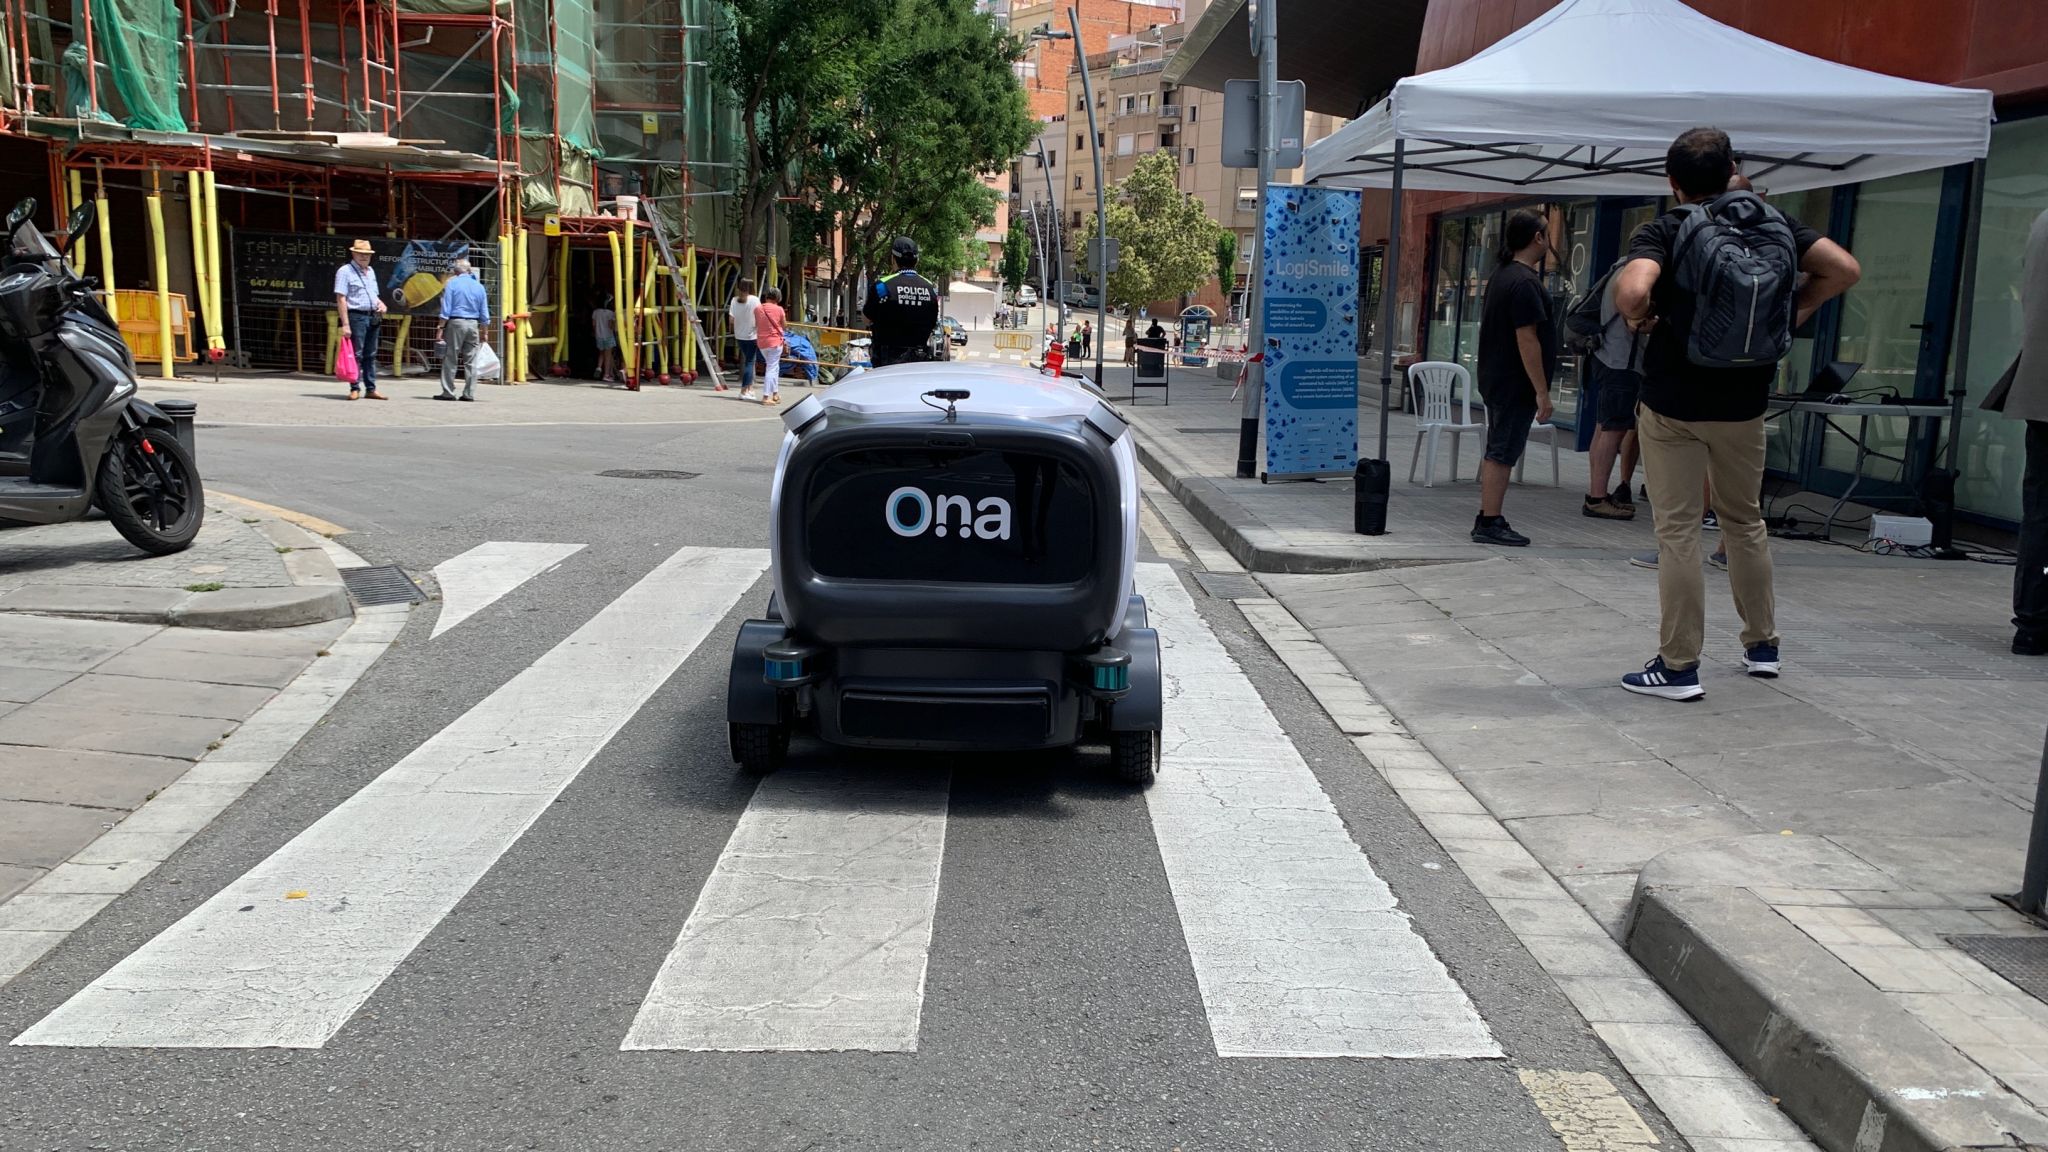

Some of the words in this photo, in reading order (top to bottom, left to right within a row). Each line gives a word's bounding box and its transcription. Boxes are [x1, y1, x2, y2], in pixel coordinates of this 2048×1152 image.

[1275, 259, 1349, 279] LogiSmile
[288, 280, 305, 289] 911
[897, 286, 930, 296] POLICIA
[885, 486, 1011, 540] Ona
